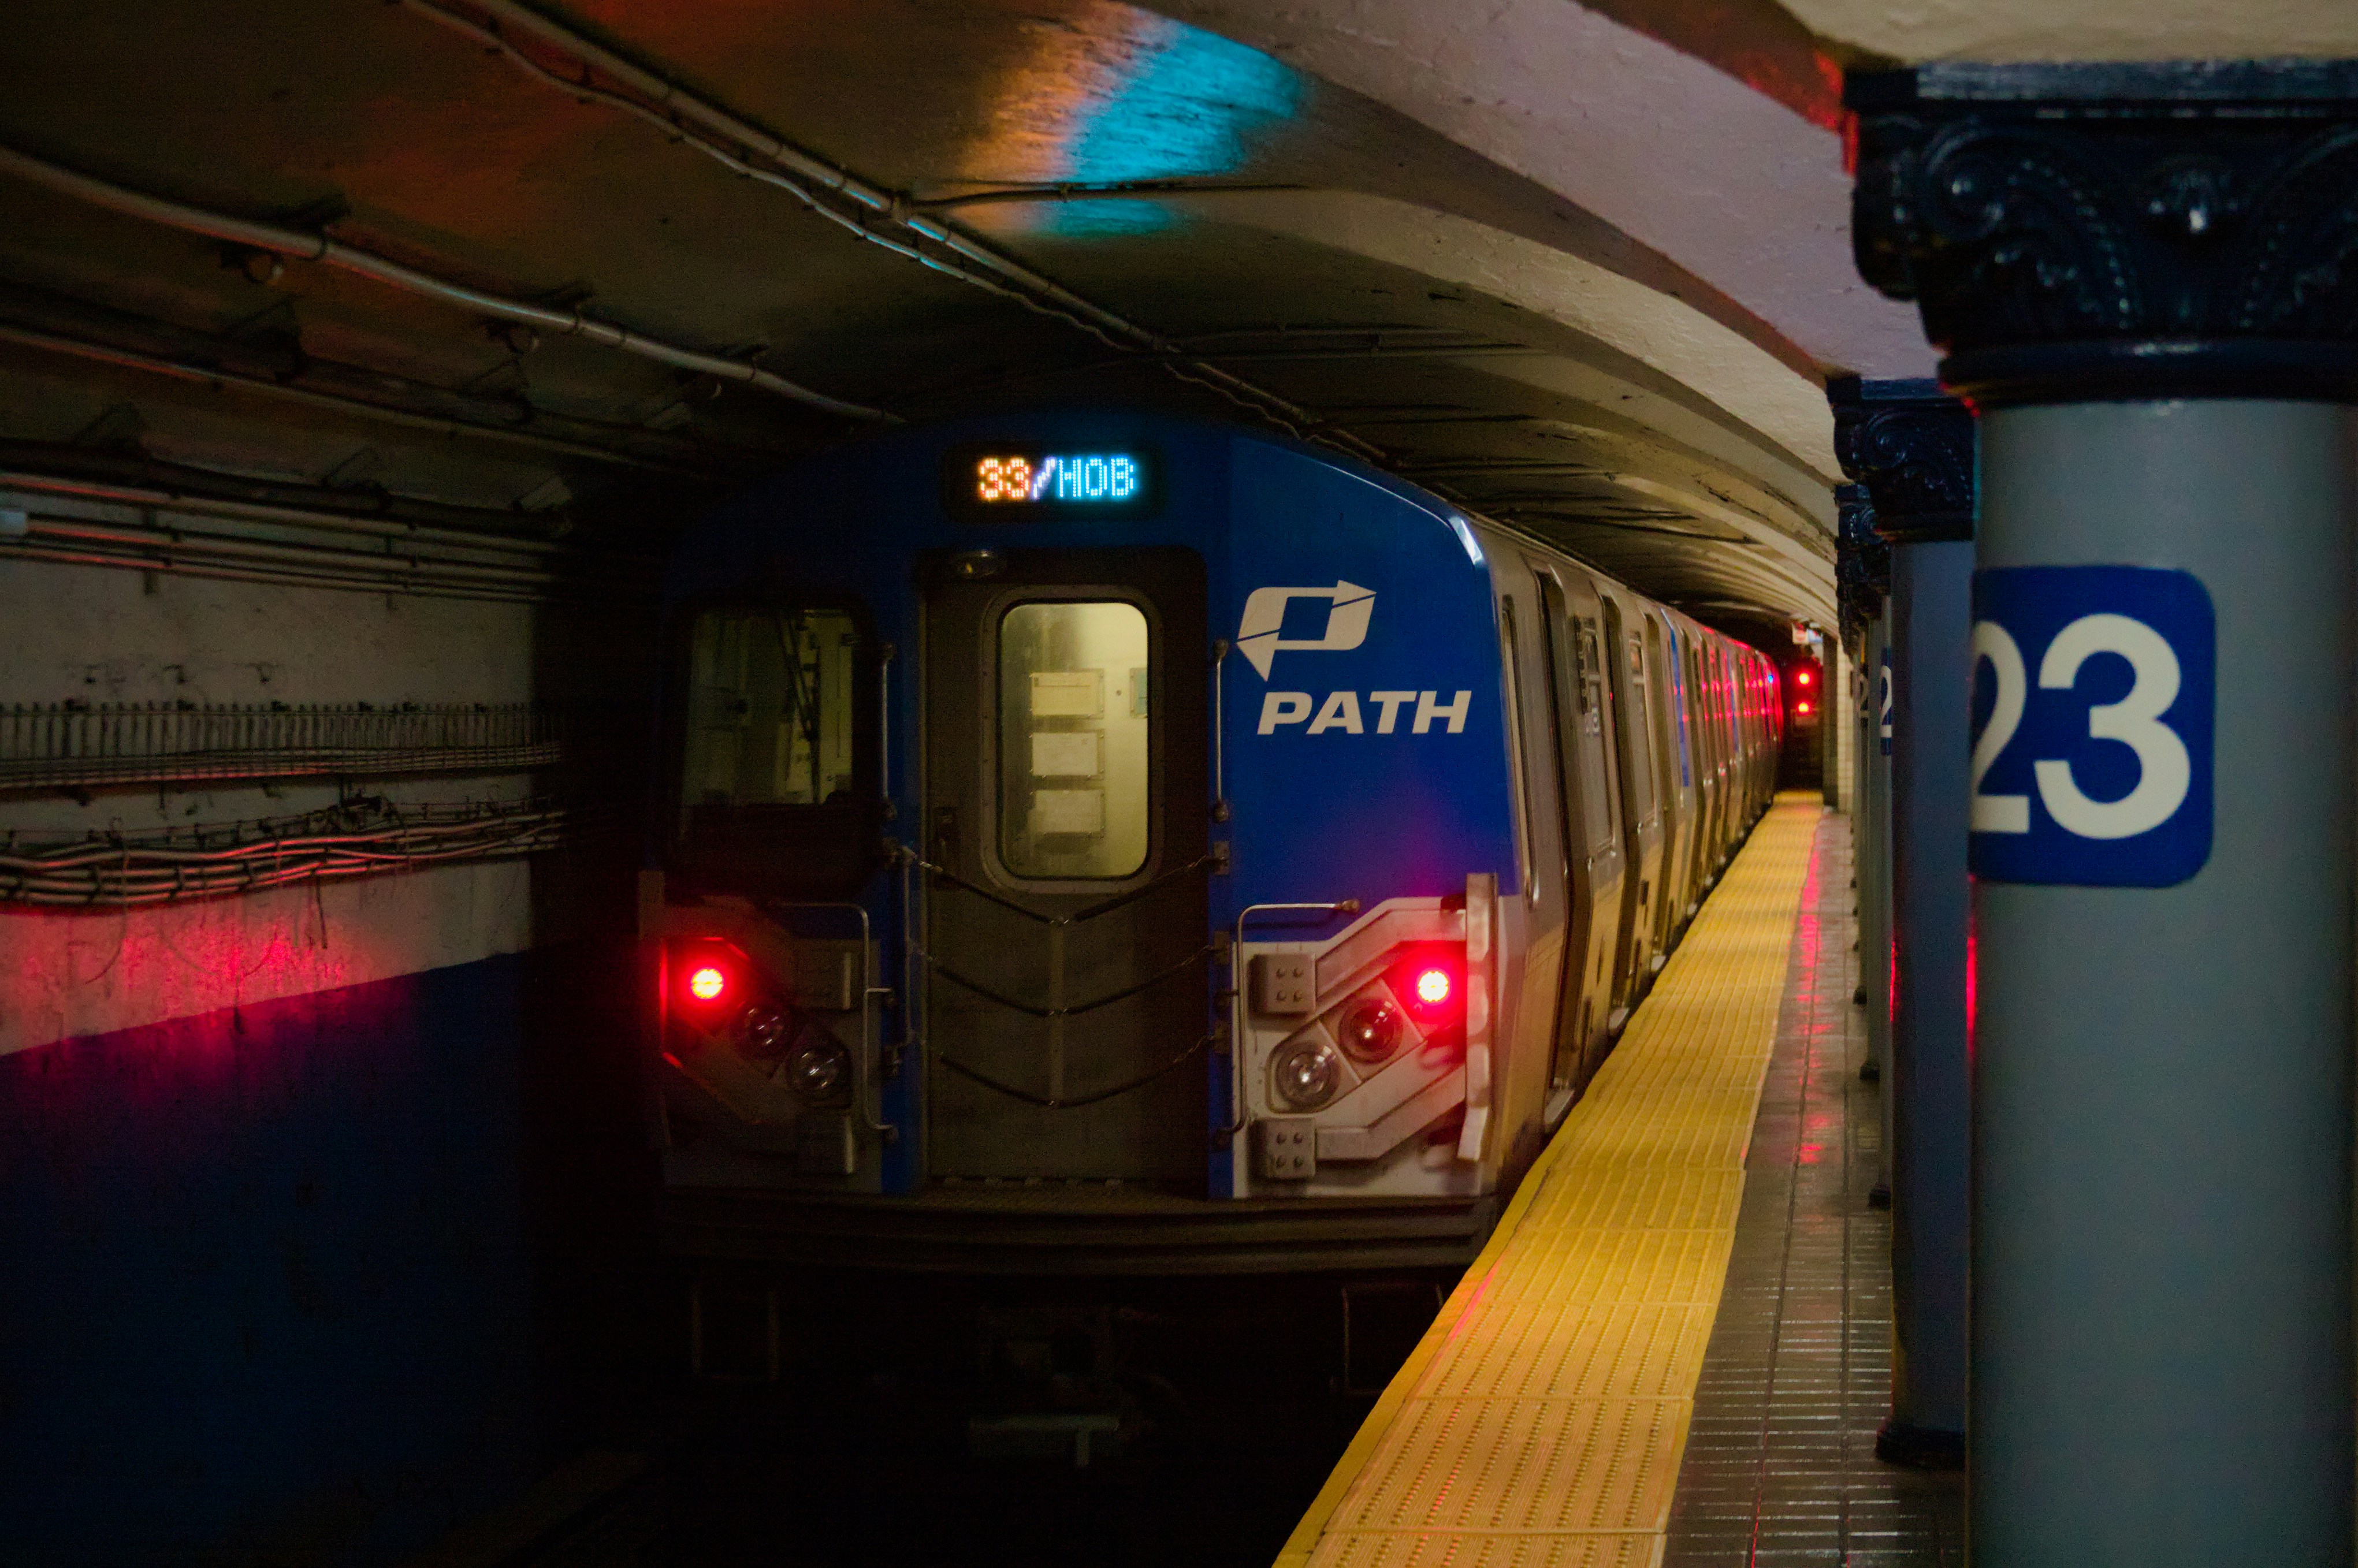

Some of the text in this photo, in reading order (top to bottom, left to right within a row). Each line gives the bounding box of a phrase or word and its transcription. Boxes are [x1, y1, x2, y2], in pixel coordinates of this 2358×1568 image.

[979, 456, 1135, 498] 33/HOB
[1257, 691, 1472, 735] PATH
[1971, 613, 2191, 840] 23
